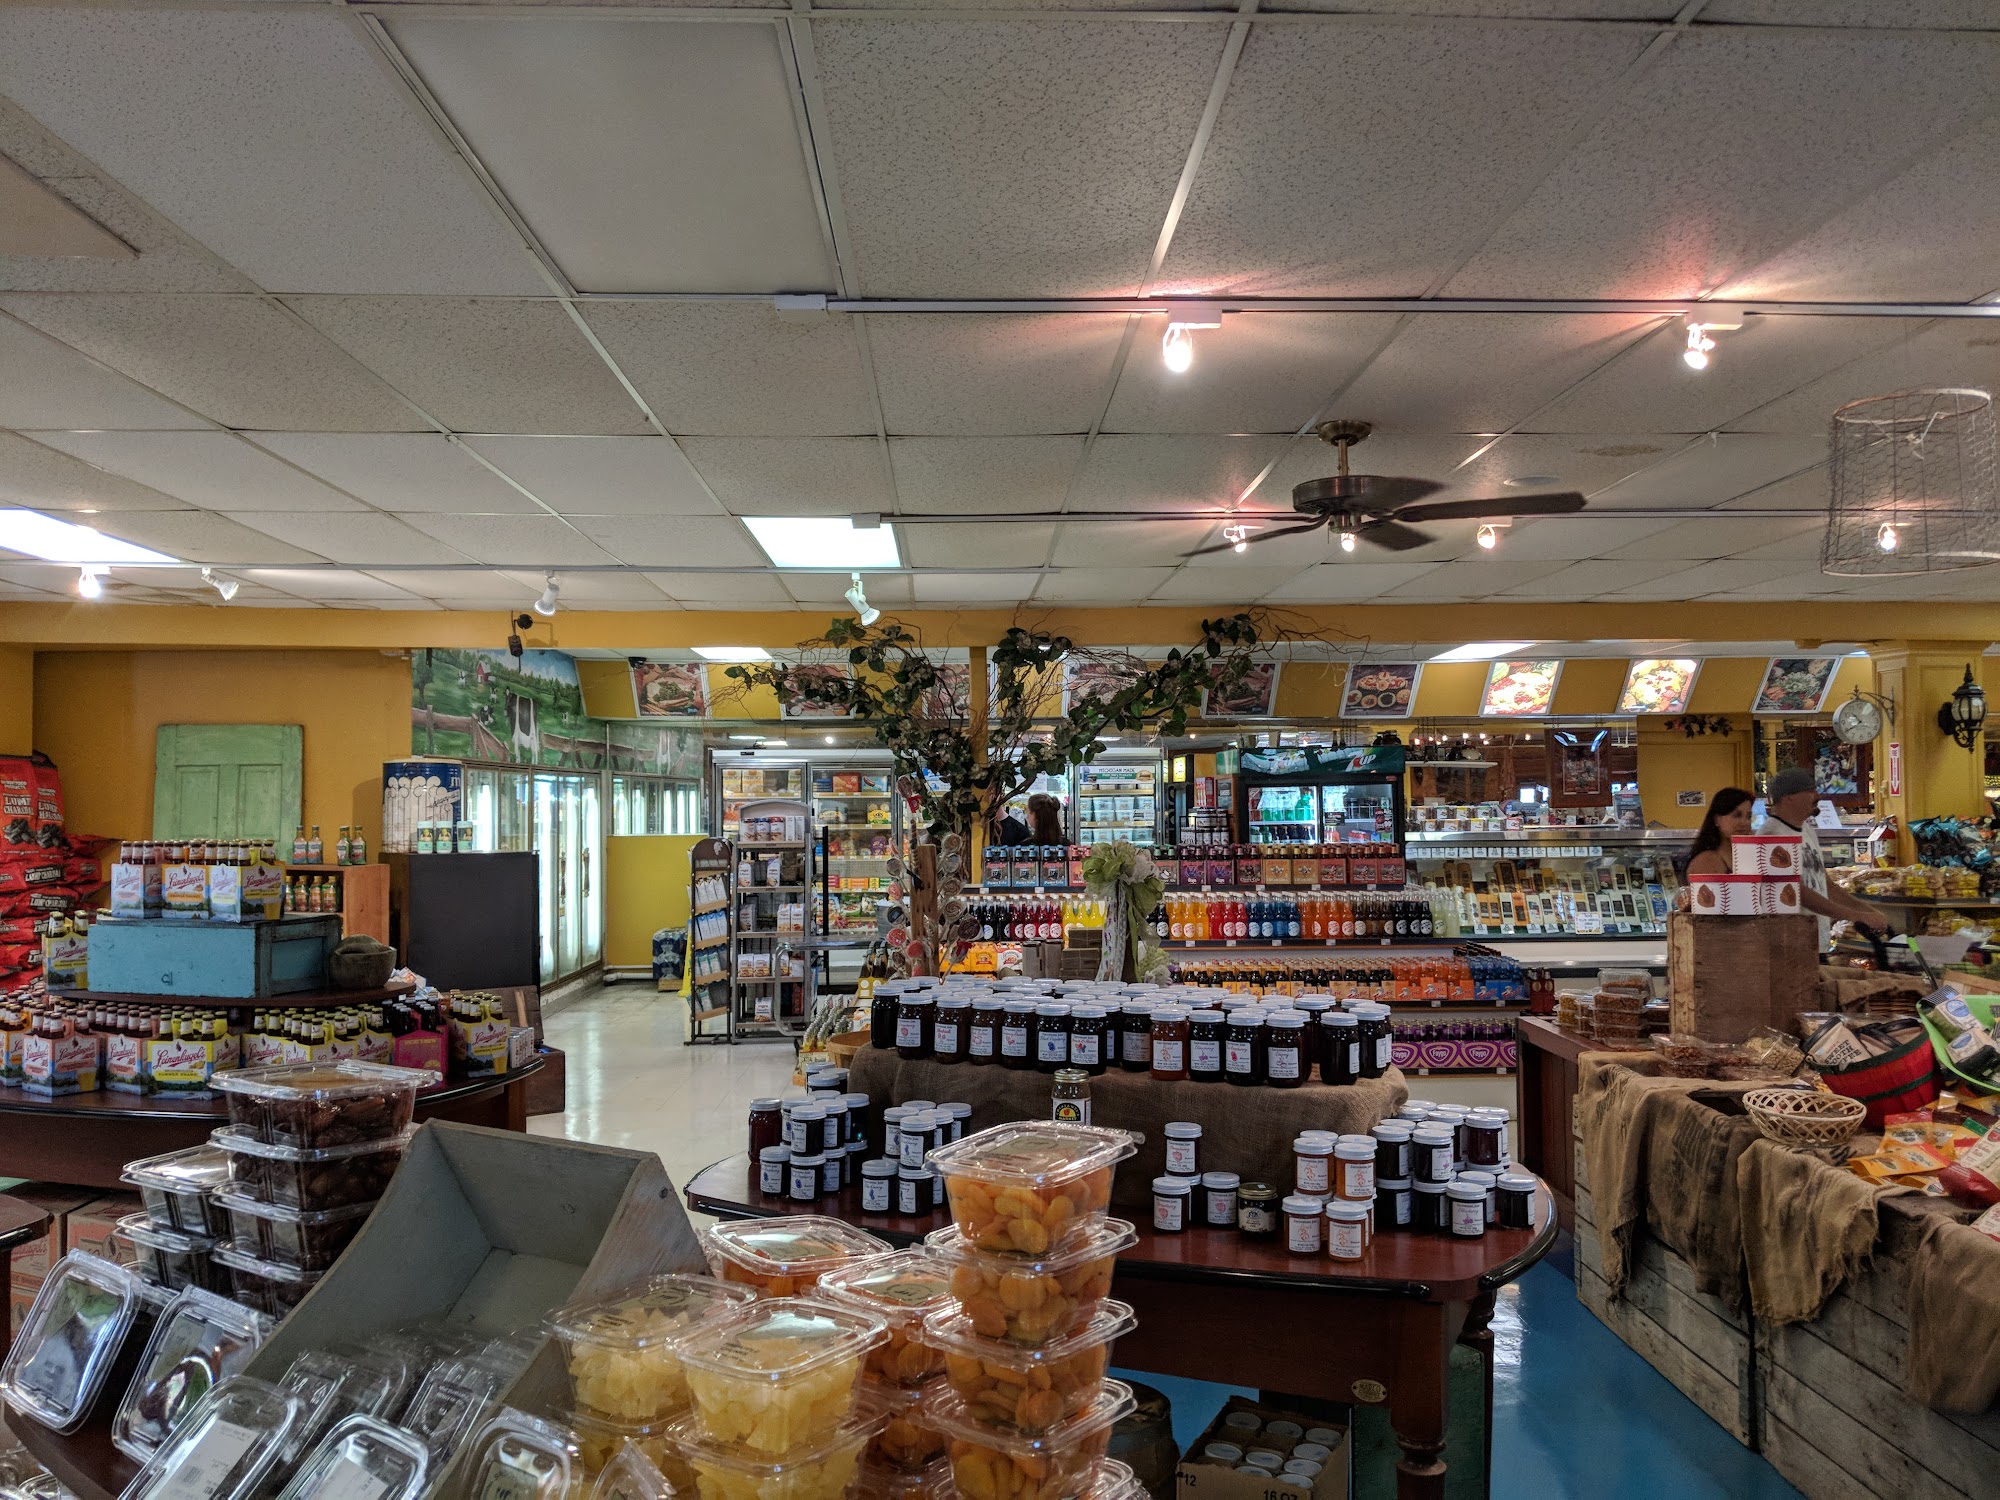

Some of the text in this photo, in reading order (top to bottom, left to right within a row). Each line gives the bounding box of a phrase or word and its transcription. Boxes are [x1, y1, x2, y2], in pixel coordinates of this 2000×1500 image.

[1393, 1049, 1409, 1059] Faygo
[1432, 1049, 1448, 1059] Faygo
[1472, 1049, 1487, 1059] Faygo
[1824, 1039, 1850, 1064] SWEET
[1830, 1045, 1854, 1064] OOTH
[153, 1046, 206, 1069] Leinenkugel's
[1263, 1489, 1277, 1500] 16
